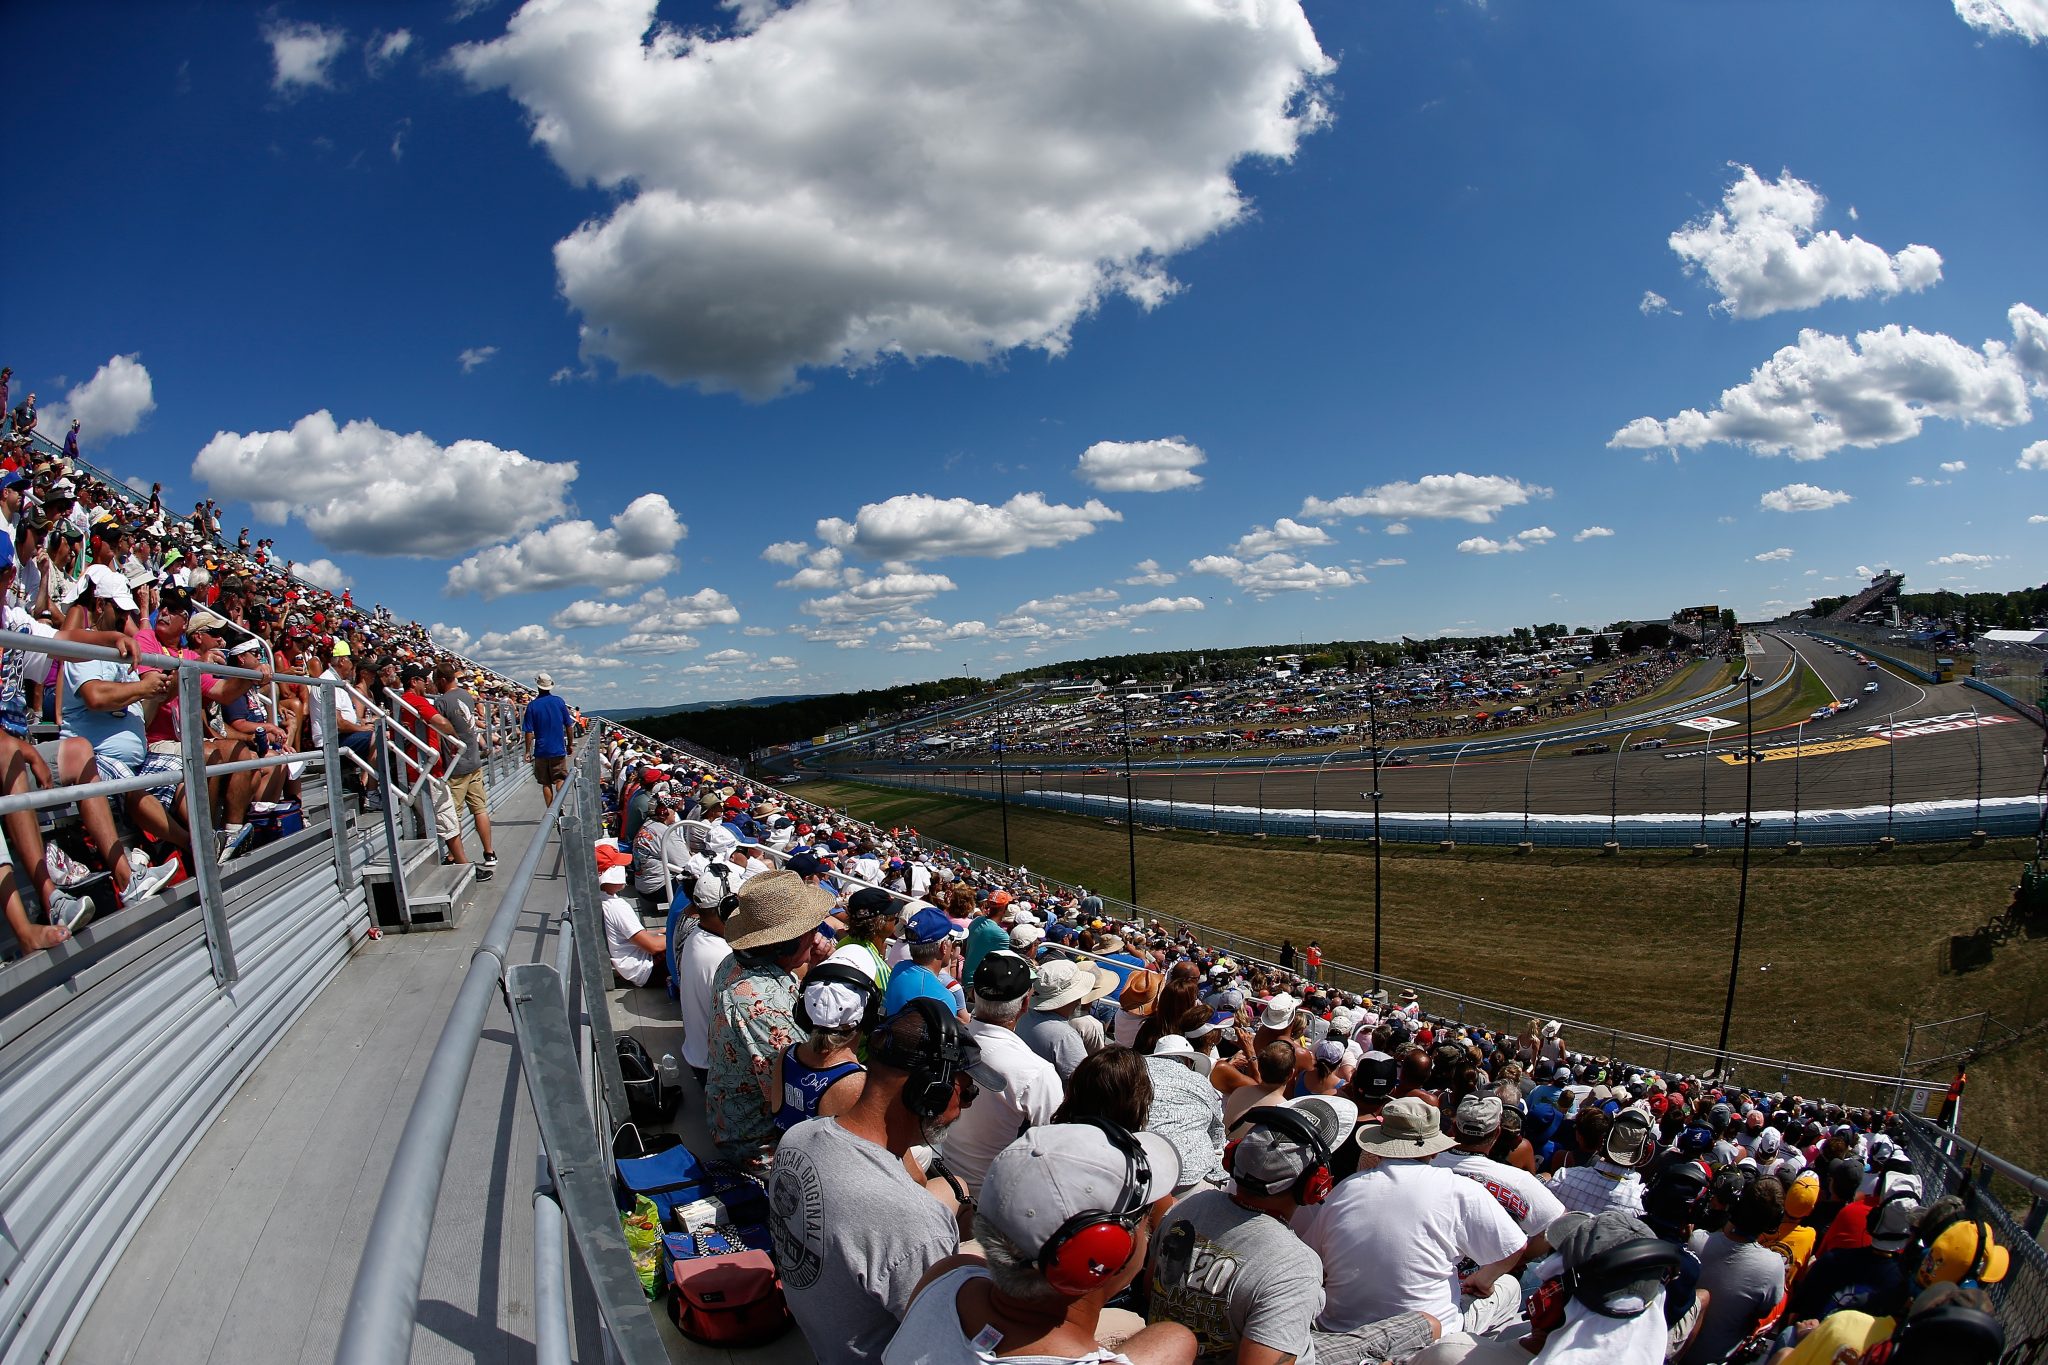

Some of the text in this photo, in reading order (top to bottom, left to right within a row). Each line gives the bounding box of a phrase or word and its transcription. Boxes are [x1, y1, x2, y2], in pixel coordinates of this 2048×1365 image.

[784, 1082, 805, 1112] 88
[801, 1166, 821, 1241] ORIGINAL
[1186, 1252, 1238, 1295] 20
